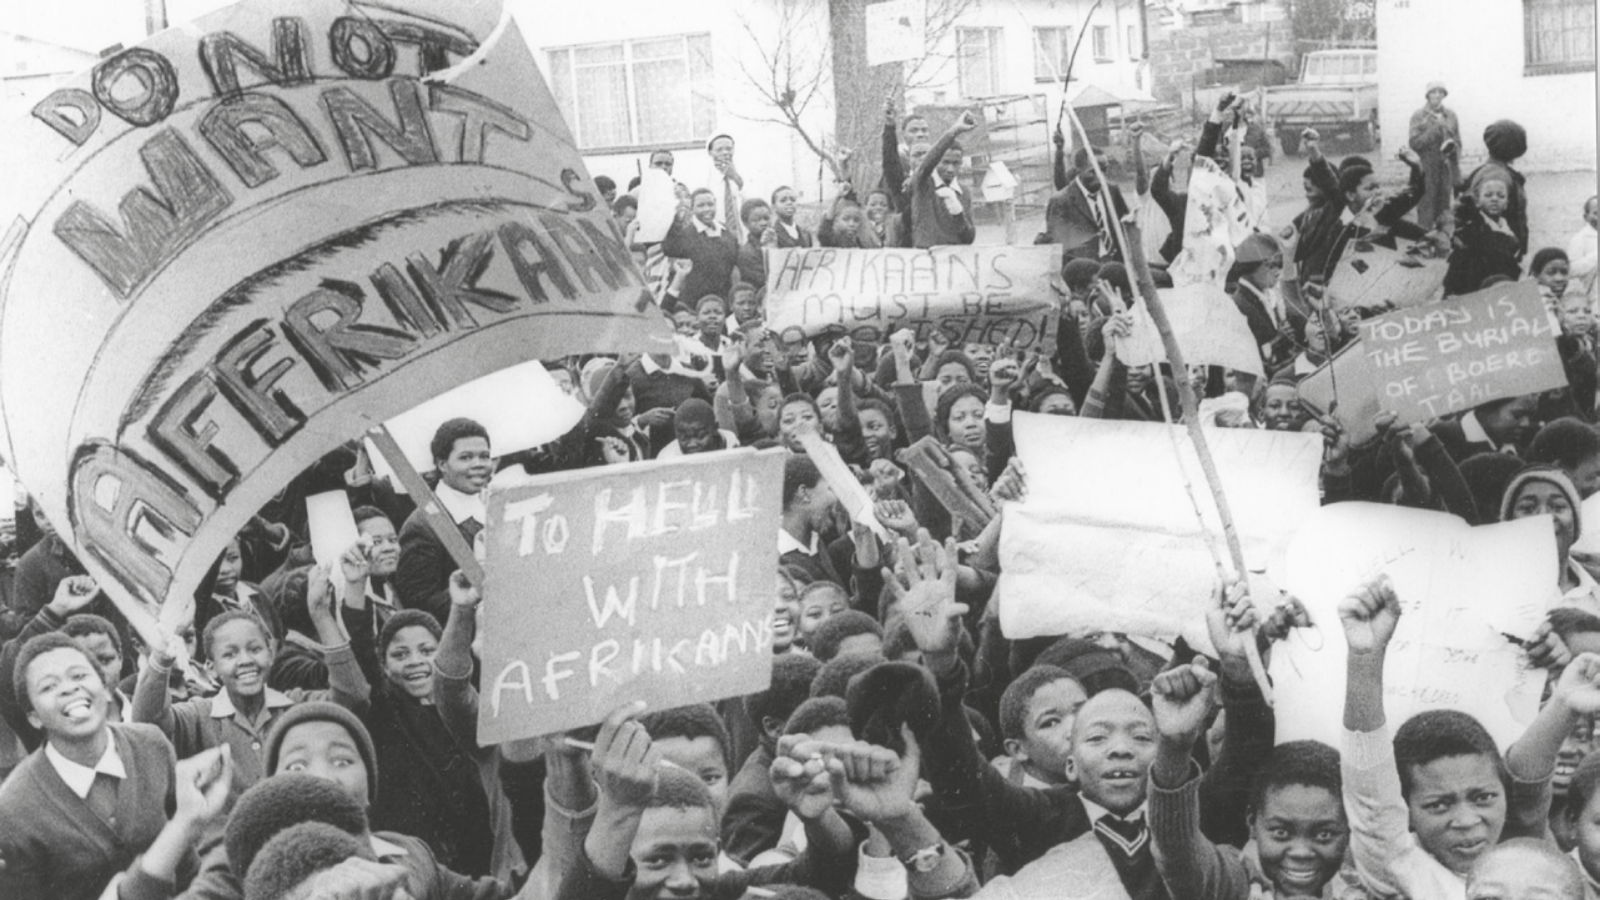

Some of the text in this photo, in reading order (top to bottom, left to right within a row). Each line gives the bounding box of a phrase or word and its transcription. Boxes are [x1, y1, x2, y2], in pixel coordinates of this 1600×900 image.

[30, 12, 482, 147] DO NOT
[774, 249, 1014, 294] AFRIKAANS
[802, 291, 1011, 326] MUST BE
[1359, 295, 1517, 342] TODAY IS
[1366, 316, 1553, 368] THE BURIAL
[1385, 348, 1543, 398] OF BOERE
[1417, 382, 1503, 417] TAAL
[591, 467, 761, 557] HELL
[582, 550, 740, 630] WITH
[490, 612, 774, 719] AFRIKAANS
